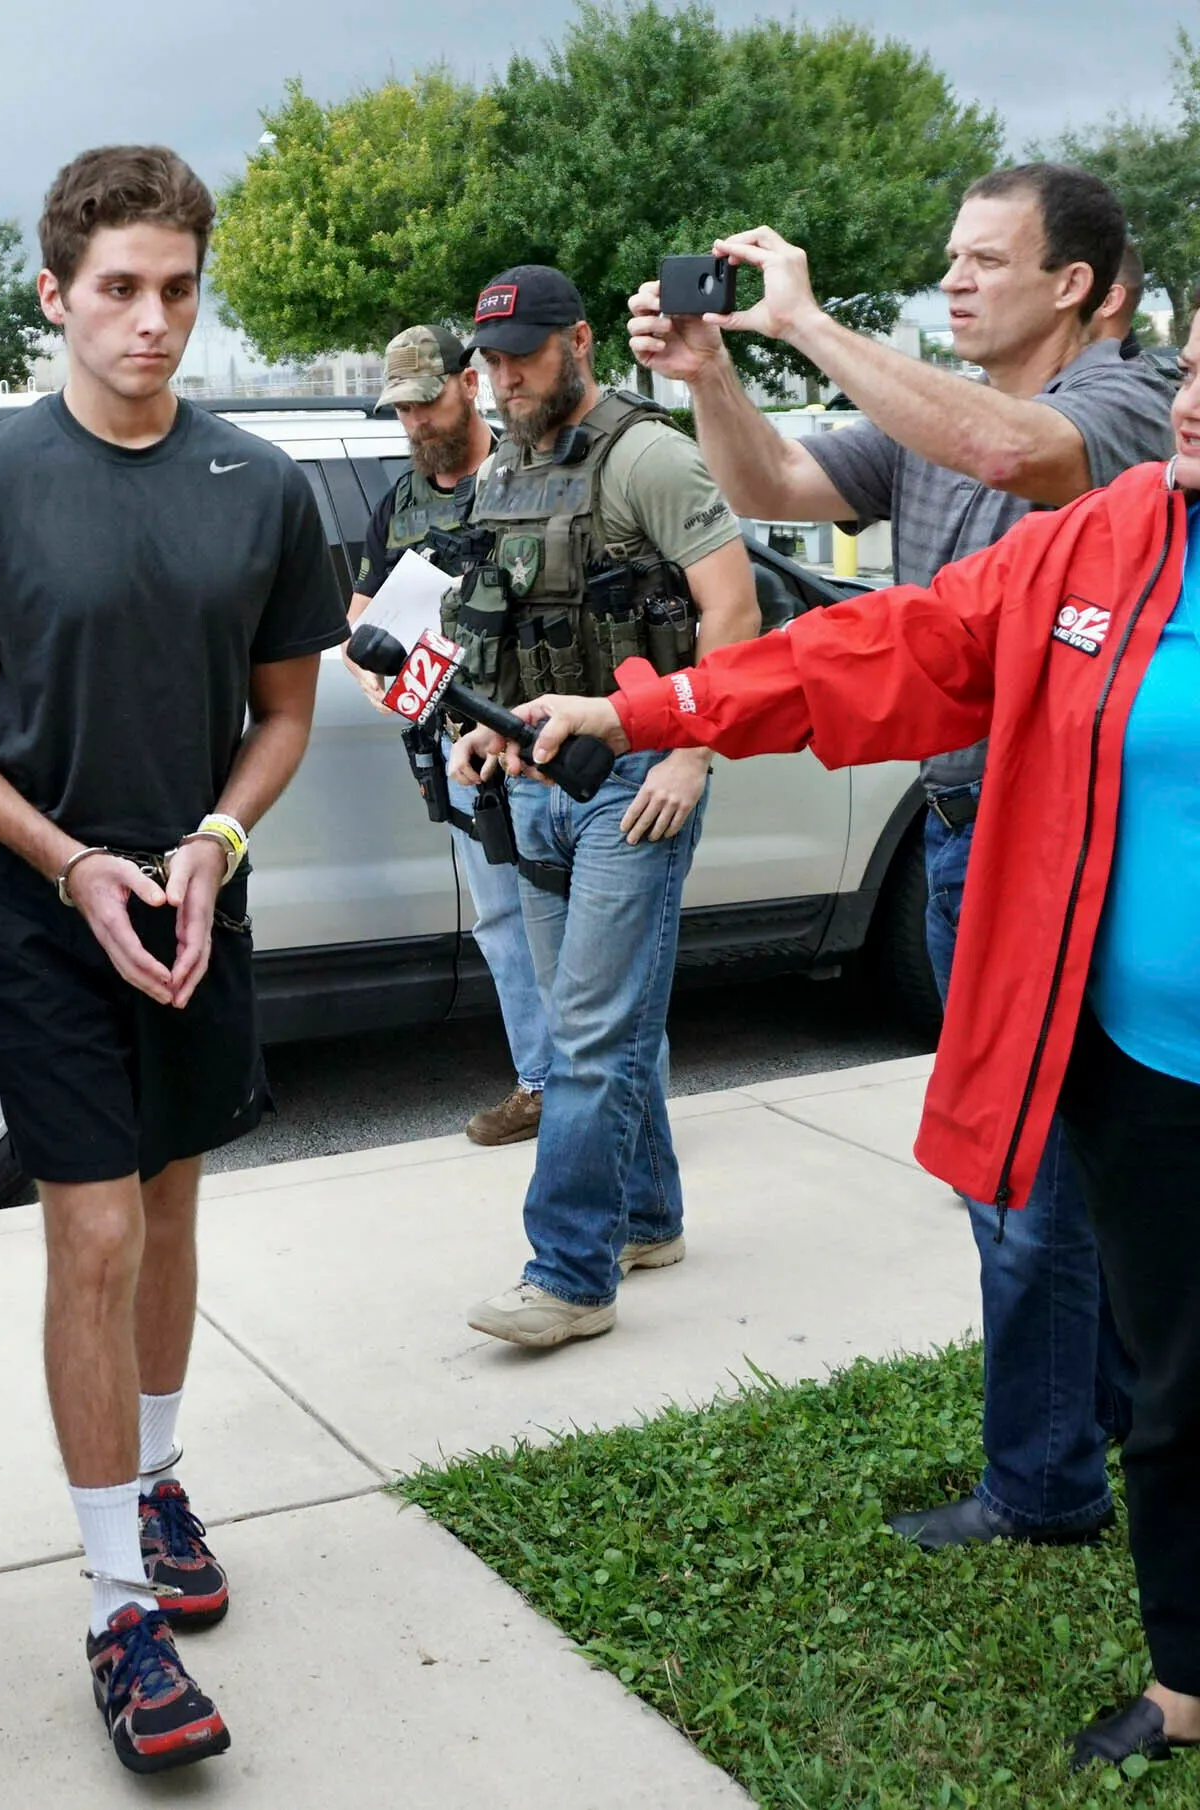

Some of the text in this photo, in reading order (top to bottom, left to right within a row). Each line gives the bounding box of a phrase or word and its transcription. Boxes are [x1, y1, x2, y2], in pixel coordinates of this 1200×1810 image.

[1053, 625, 1098, 653] NEWS
[402, 647, 443, 702] 12
[417, 663, 460, 724] CBS12.COM
